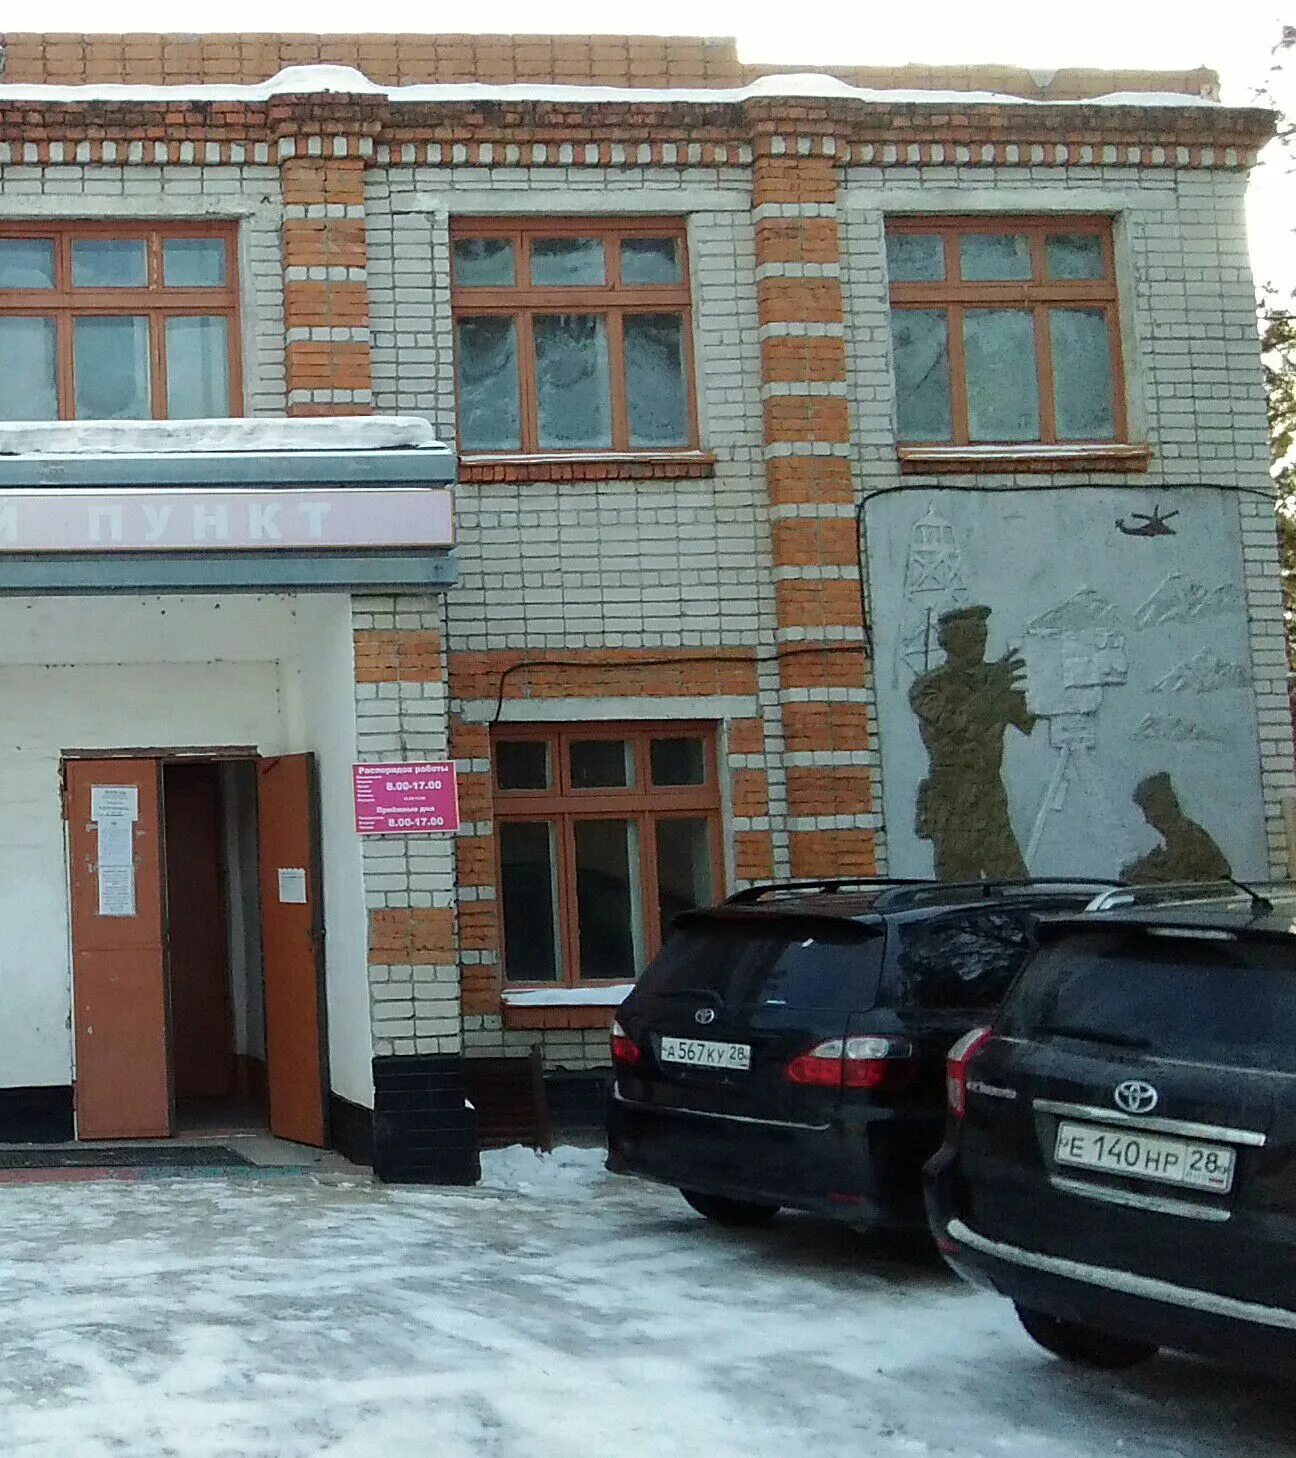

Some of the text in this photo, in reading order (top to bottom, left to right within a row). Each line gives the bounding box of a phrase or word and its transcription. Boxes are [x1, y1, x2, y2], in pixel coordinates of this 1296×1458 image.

[88, 502, 332, 541] ПУНКТ
[415, 764, 449, 775] работы
[386, 781, 442, 791] 8.00-17.00
[729, 1046, 744, 1061] 28
[1189, 1150, 1218, 1173] 28
